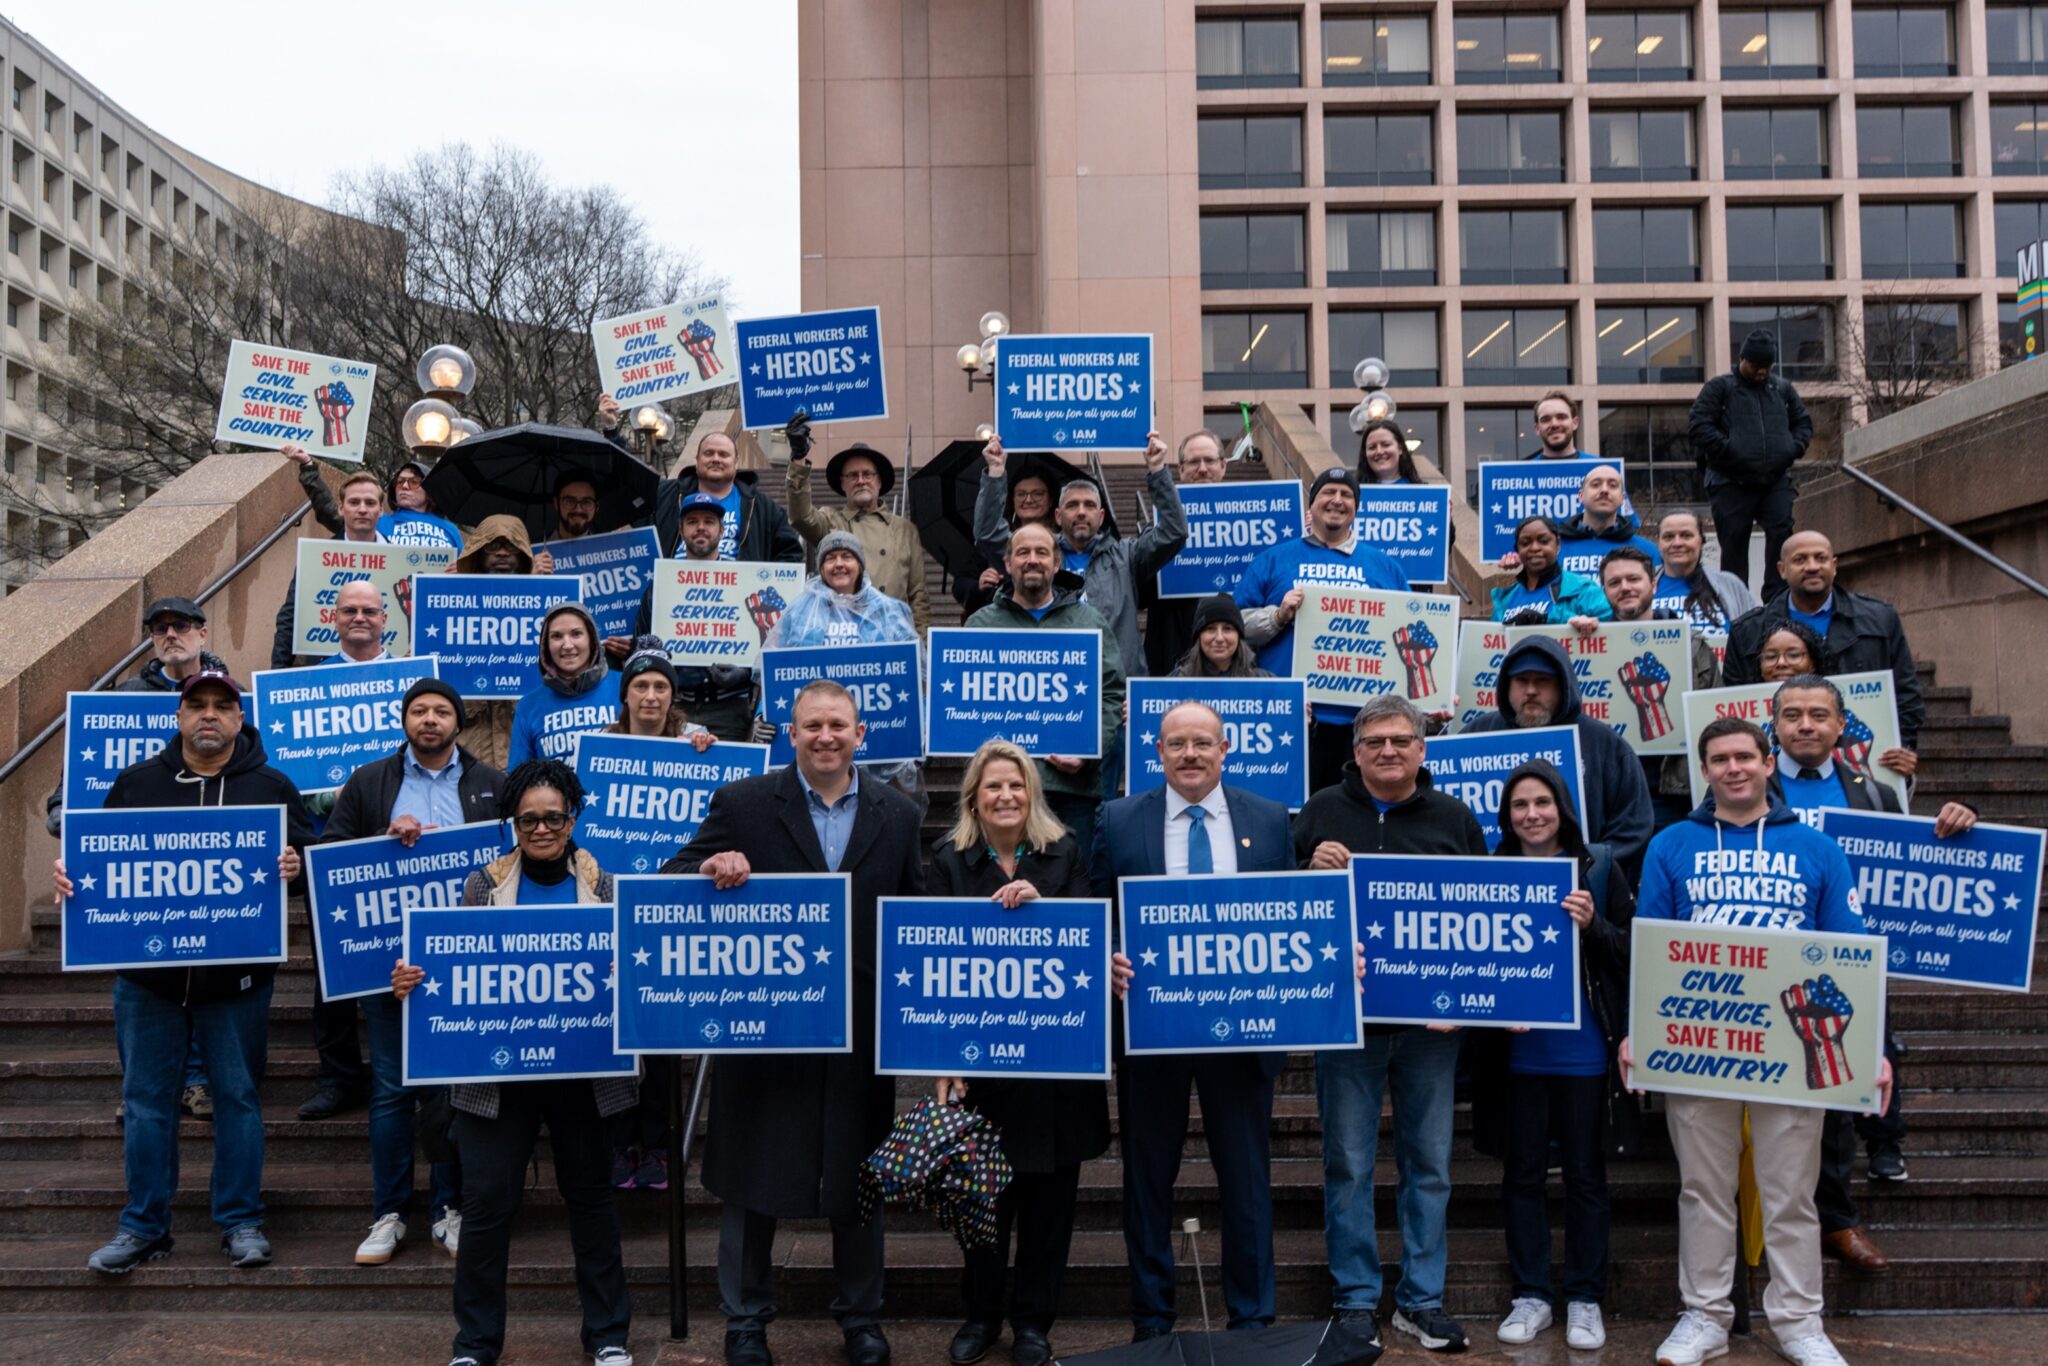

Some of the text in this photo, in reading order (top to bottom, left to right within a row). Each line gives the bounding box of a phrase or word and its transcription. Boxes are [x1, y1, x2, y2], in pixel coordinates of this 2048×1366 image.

[2017, 242, 2038, 288] M
[698, 300, 718, 310] IAM
[613, 315, 668, 339] SAVE THE
[748, 325, 868, 349] FEDERAL WORKERS ARE
[625, 333, 659, 352] CIVIL
[250, 354, 310, 376] SAVE THE
[615, 345, 676, 370] SERVICE,
[766, 346, 856, 380] HEROES
[1009, 353, 1139, 367] FEDERAL WORKERS ARE
[256, 372, 294, 390] CIVIL
[345, 367, 367, 377] IAM
[622, 360, 676, 383] SAVE THE
[616, 372, 689, 399] COUNTRY!
[755, 378, 869, 398] Thank you for all you do!
[1027, 373, 1123, 402] HEROES
[239, 386, 307, 410] SERVICE,
[812, 403, 834, 413] IAM
[242, 402, 302, 424] SAVE THE
[229, 417, 314, 442] COUNTRY!
[1073, 430, 1096, 439] IAM
[1492, 478, 1535, 490] FEDERAL
[1215, 499, 1291, 514] WORKERS ARE
[1367, 501, 1415, 512] WORKERS
[1418, 502, 1438, 512] ARE
[393, 521, 448, 541] FEDERAL
[1185, 519, 1277, 548] HEROES
[322, 552, 386, 570] SAVE THE
[577, 544, 650, 566] WORKERS ARE
[677, 571, 738, 586] SAVE THE
[775, 570, 797, 578] IAM
[1299, 563, 1366, 581] FEDERAL
[427, 595, 540, 608] FEDERAL WORKERS
[685, 589, 724, 603] CIVIL
[670, 605, 740, 621] SERVICE,
[1321, 597, 1386, 617] SAVE THE
[1426, 602, 1450, 612] IAM
[676, 623, 736, 637] SAVE THE
[1329, 617, 1370, 636] CIVIL
[1653, 629, 1681, 639] IAM
[664, 640, 750, 654] COUNTRY!
[1312, 635, 1386, 657] SERVICE,
[1578, 637, 1607, 654] THE
[943, 649, 1086, 664] FEDERAL WORKERS ARE
[1317, 654, 1382, 675] SAVE THE
[775, 662, 907, 681] FEDERAL WORKERS ARE
[270, 680, 394, 705] FEDERAL WORKERS
[962, 671, 1068, 702] HEROES
[1850, 682, 1882, 694] IAM
[1267, 700, 1292, 714] ARE
[83, 714, 142, 730] FEDERAL
[544, 705, 619, 733] FEDERAL
[589, 757, 720, 781] FEDERAL WORKERS
[81, 830, 266, 853] FEDERAL WORKERS ARE
[1695, 850, 1801, 878] FEDERAL
[1836, 837, 2024, 872] FEDERAL WORKERS ARE
[106, 858, 243, 899] HEROES
[328, 852, 468, 888] FEDERAL WORKERS
[1368, 882, 1557, 903] FEDERAL WORKERS ARE
[1686, 876, 1807, 906] WORKERS
[1856, 866, 1997, 917] HEROES
[85, 903, 262, 926] Thank you for all you do!
[634, 903, 829, 924] FEDERAL WORKERS ARE
[1140, 900, 1334, 924] FEDERAL WORKERS ARE
[172, 936, 206, 949] IAM
[897, 926, 1089, 947] FEDERAL WORKERS ARE
[1394, 911, 1533, 953] HEROES
[425, 933, 581, 955] FEDERAL WORKERS
[1168, 932, 1312, 976] HEROES
[1668, 940, 1768, 969] SAVE THE
[1833, 946, 1872, 961] IAM
[661, 934, 805, 976] HEROES
[1916, 951, 1950, 966] IAM
[923, 957, 1064, 999] HEROES
[1372, 958, 1554, 981] Thank you for all you do!
[452, 962, 594, 1006] HEROES
[1680, 969, 1744, 996] CIVIL
[638, 986, 826, 1007] Thank you for all you do!
[1461, 994, 1495, 1007] IAM
[1656, 995, 1772, 1028] SERVICE,
[730, 1020, 765, 1034] IAM
[1240, 1019, 1275, 1033] IAM
[1665, 1023, 1765, 1053] SAVE THE
[520, 1047, 555, 1061] IAM
[990, 1044, 1024, 1057] IAM
[1646, 1049, 1788, 1084] COUNTRY!
